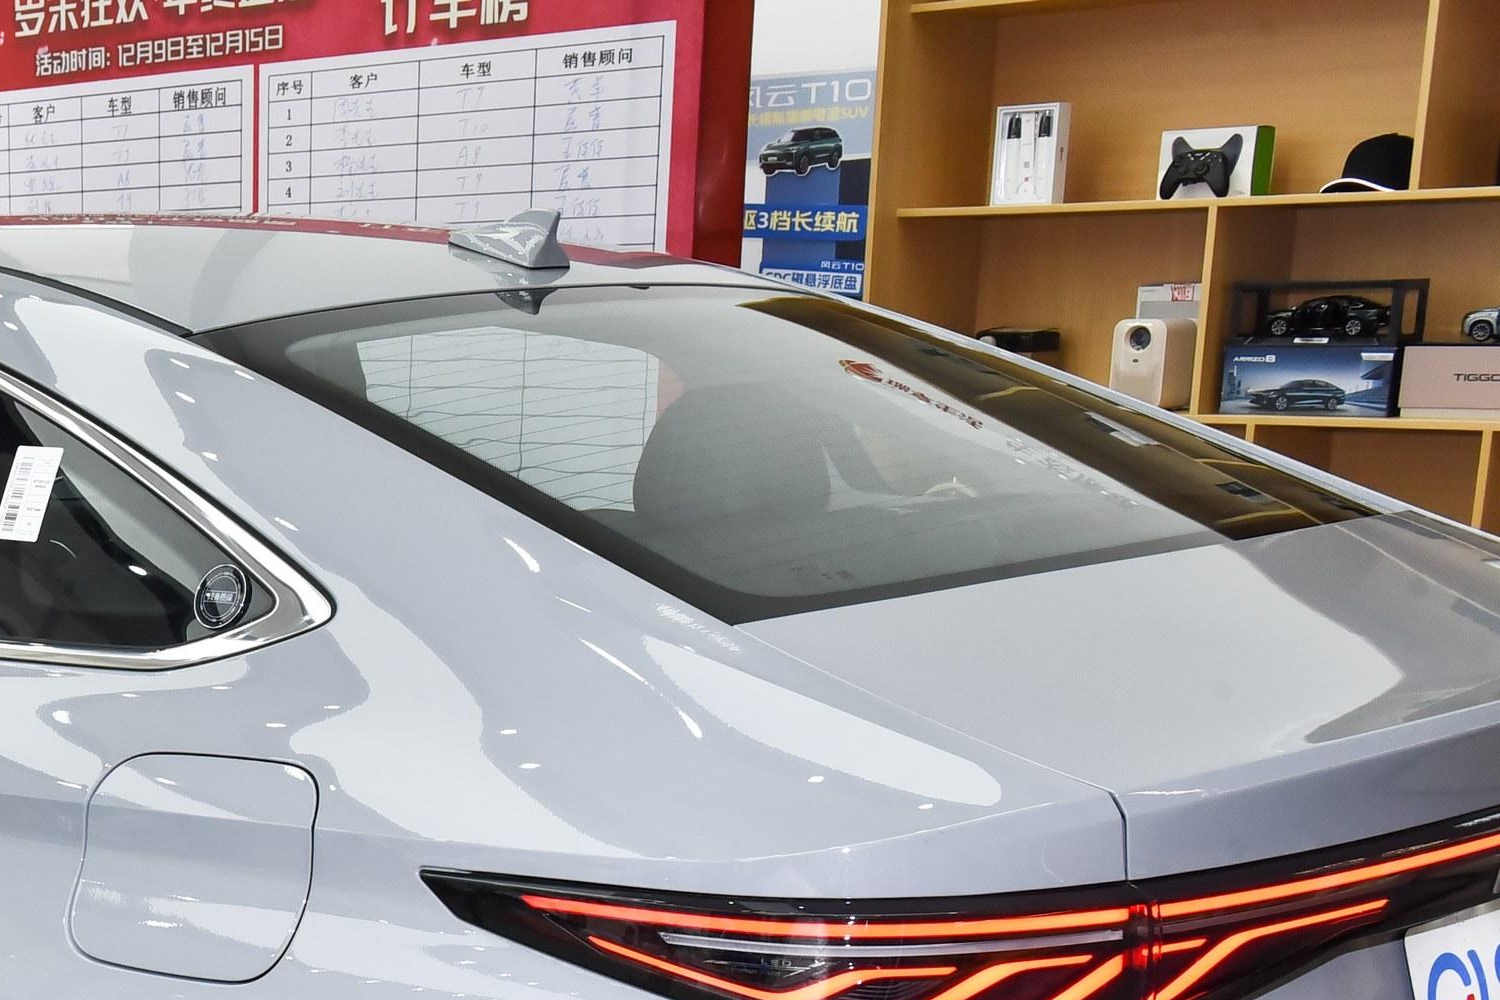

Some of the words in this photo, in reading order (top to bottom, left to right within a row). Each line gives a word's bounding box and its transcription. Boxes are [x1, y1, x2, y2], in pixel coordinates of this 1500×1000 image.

[276, 79, 304, 96] 序号
[350, 72, 378, 89] 客户
[460, 60, 491, 78] 车型
[563, 47, 633, 69] 销售顾问
[32, 104, 55, 124] 客户
[107, 96, 132, 116] 车型
[172, 87, 227, 110] 销售顾问
[285, 134, 293, 147] 2
[285, 160, 293, 173] 3
[285, 186, 292, 199] 4
